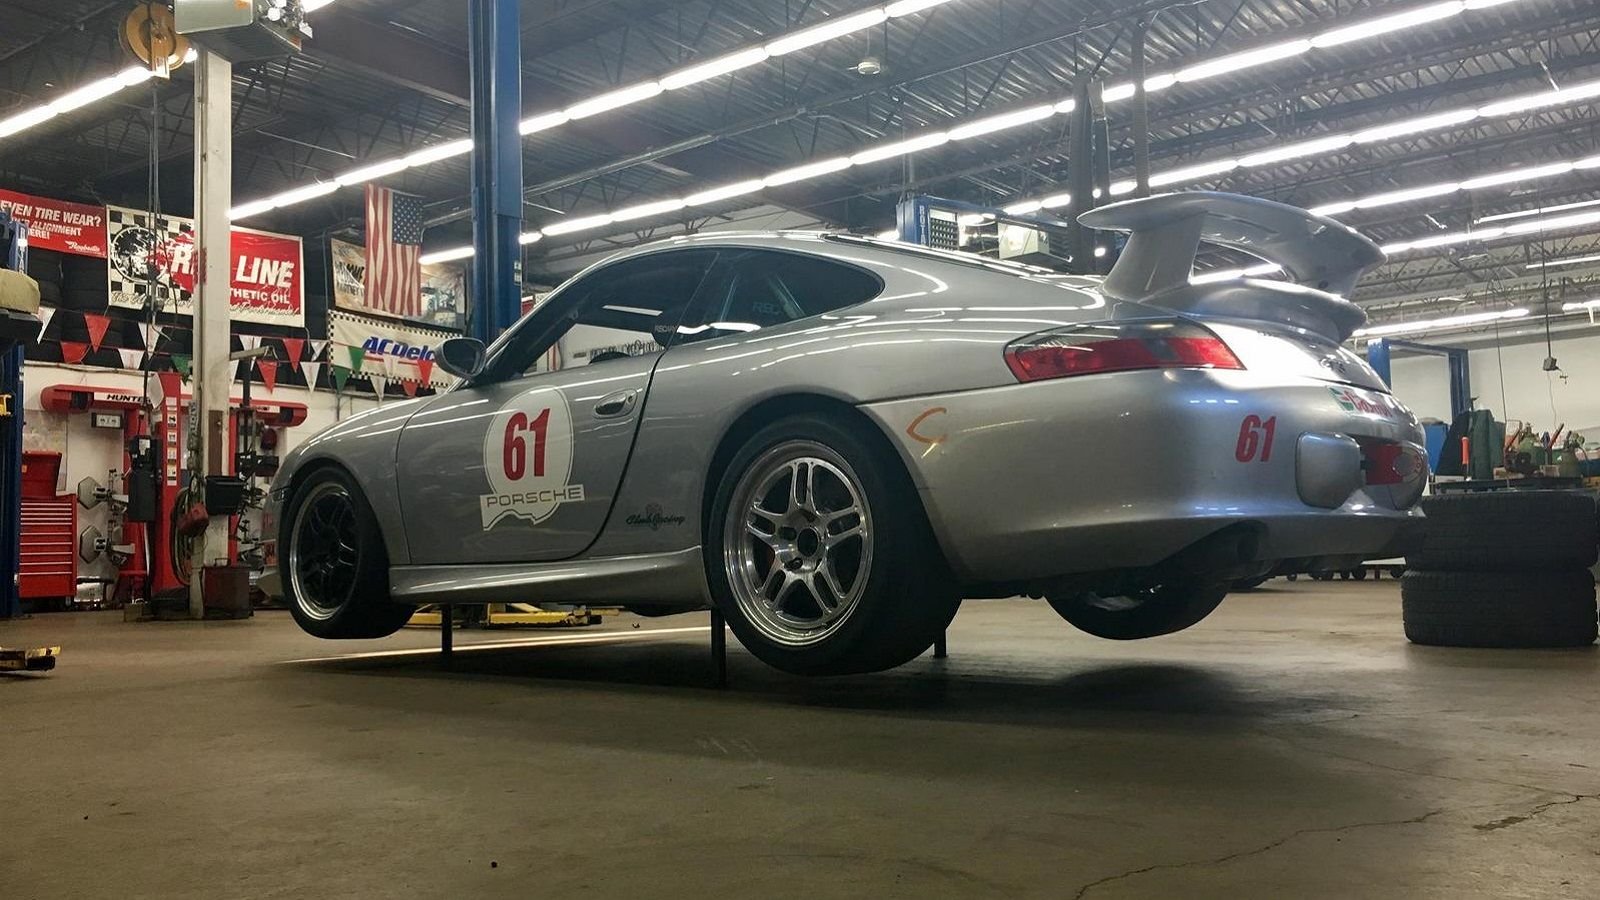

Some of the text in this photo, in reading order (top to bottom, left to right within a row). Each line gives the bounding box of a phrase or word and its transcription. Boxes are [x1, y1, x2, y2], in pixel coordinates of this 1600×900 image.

[31, 220, 82, 236] ALIGNMENT
[35, 206, 61, 222] TIRE
[63, 211, 101, 227] WEAR?
[235, 255, 295, 288] LINE
[270, 292, 290, 304] OIL
[362, 336, 437, 362] ACDelc
[503, 408, 551, 481] 61
[1235, 414, 1277, 463] 61
[487, 487, 584, 508] PORSCHE
